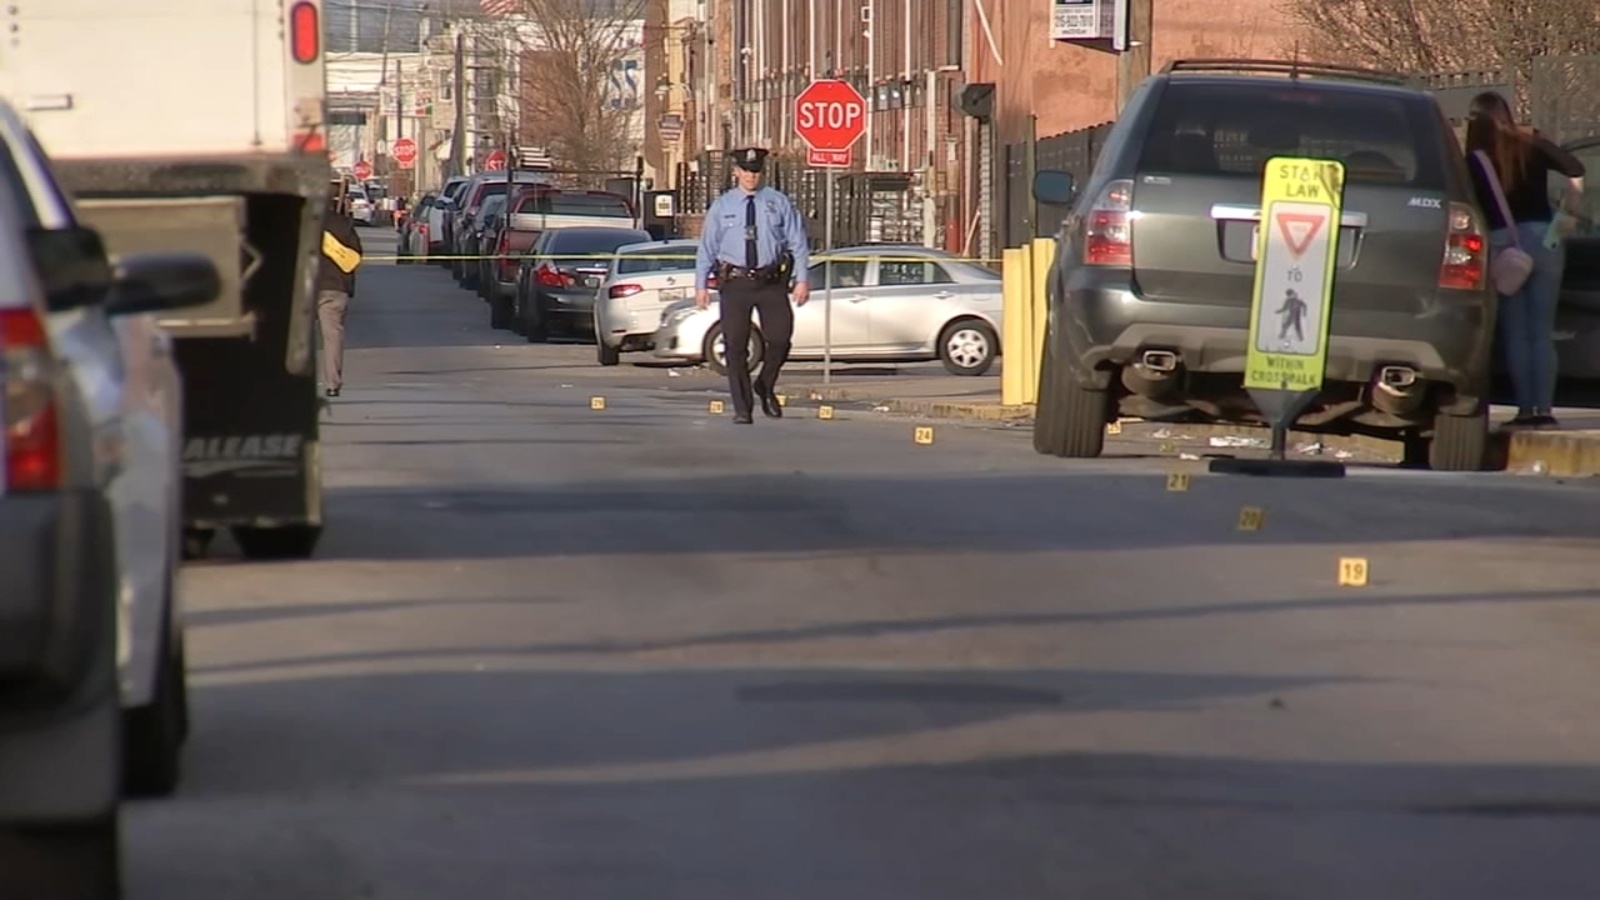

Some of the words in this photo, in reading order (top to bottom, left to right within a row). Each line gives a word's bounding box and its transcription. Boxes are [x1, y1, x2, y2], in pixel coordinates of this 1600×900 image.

[799, 102, 861, 129] STOP
[394, 145, 415, 156] STOP
[811, 152, 825, 162] ALL
[832, 153, 847, 163] WAY
[1286, 183, 1319, 198] LAW
[1407, 197, 1441, 209] MDX
[1287, 270, 1303, 283] TO
[1266, 357, 1305, 370] WITHIN
[918, 429, 930, 441] 24
[1170, 473, 1186, 488] 21
[1344, 563, 1362, 581] 19
